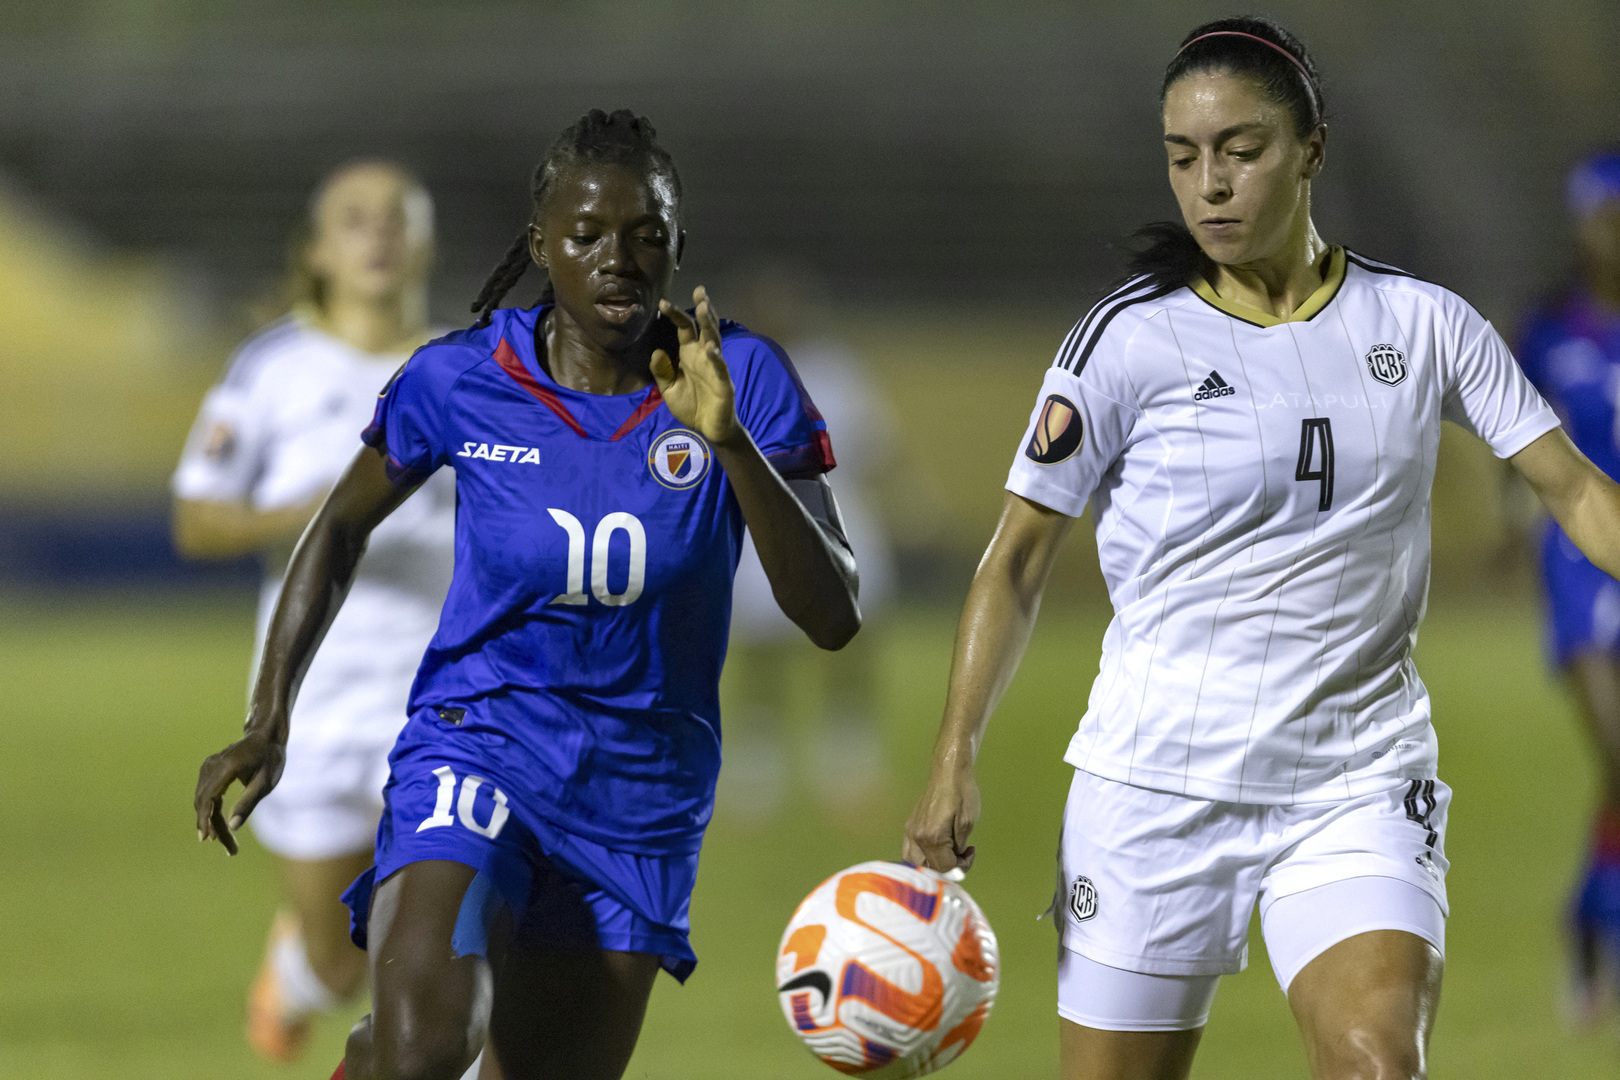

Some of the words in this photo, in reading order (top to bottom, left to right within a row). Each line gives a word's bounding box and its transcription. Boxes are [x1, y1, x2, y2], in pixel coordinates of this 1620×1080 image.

[1194, 385, 1236, 401] adidas
[1249, 392, 1389, 410] CATAPULT
[456, 441, 540, 465] SAETA
[1295, 417, 1335, 512] 4
[546, 507, 647, 607] 10
[415, 765, 510, 840] 10
[1403, 778, 1438, 849] 4
